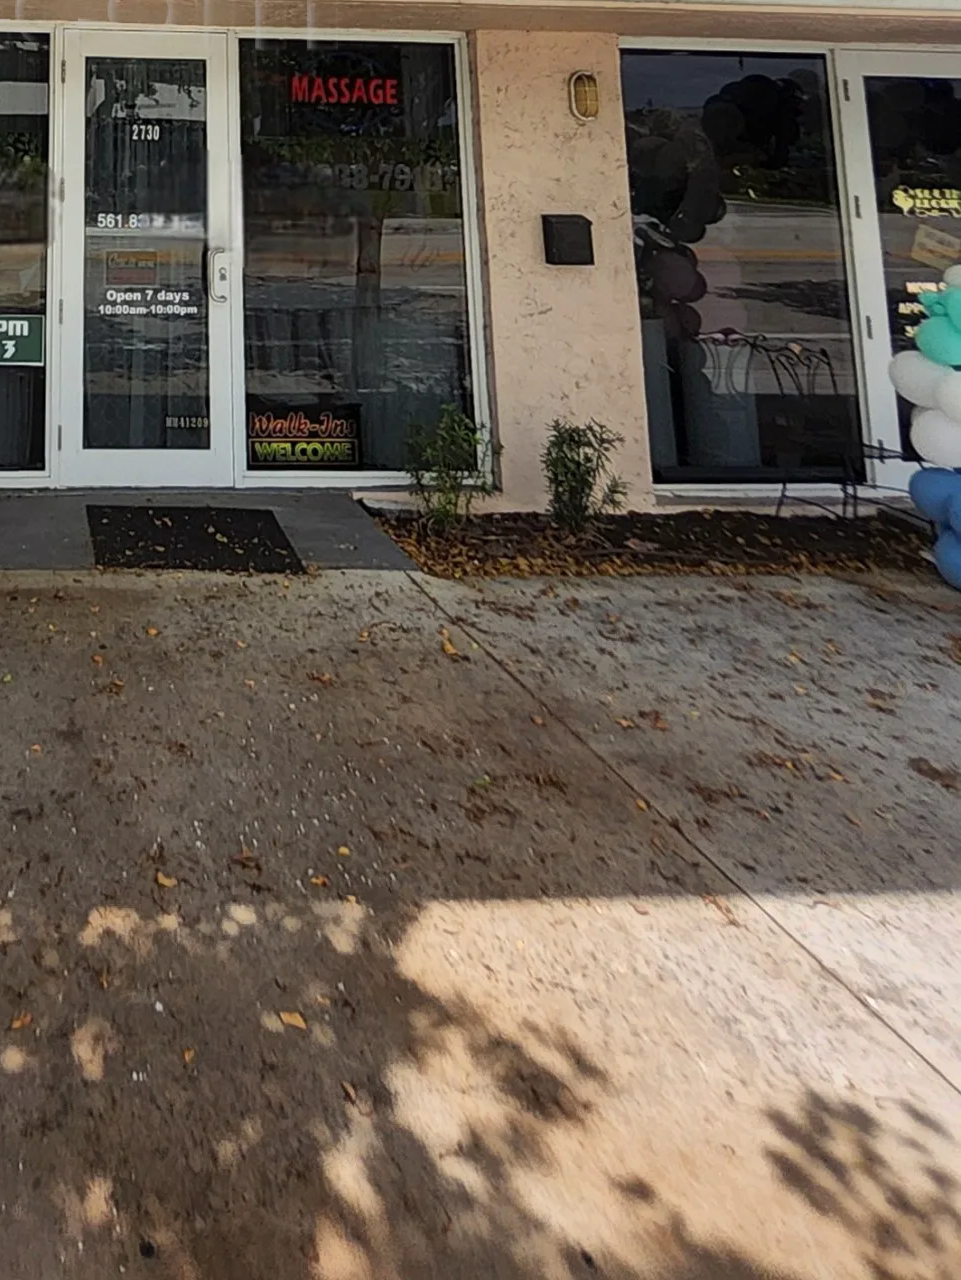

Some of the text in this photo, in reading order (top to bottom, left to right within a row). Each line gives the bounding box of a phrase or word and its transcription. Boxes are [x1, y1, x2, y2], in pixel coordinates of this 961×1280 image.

[290, 74, 398, 105] MASSAGE
[131, 124, 160, 141] 2730
[106, 290, 190, 303] Open 7 days
[98, 305, 198, 316] 10:00am-10:00pm
[249, 411, 357, 437] Walk-Ins
[254, 441, 353, 462] WELCOME
